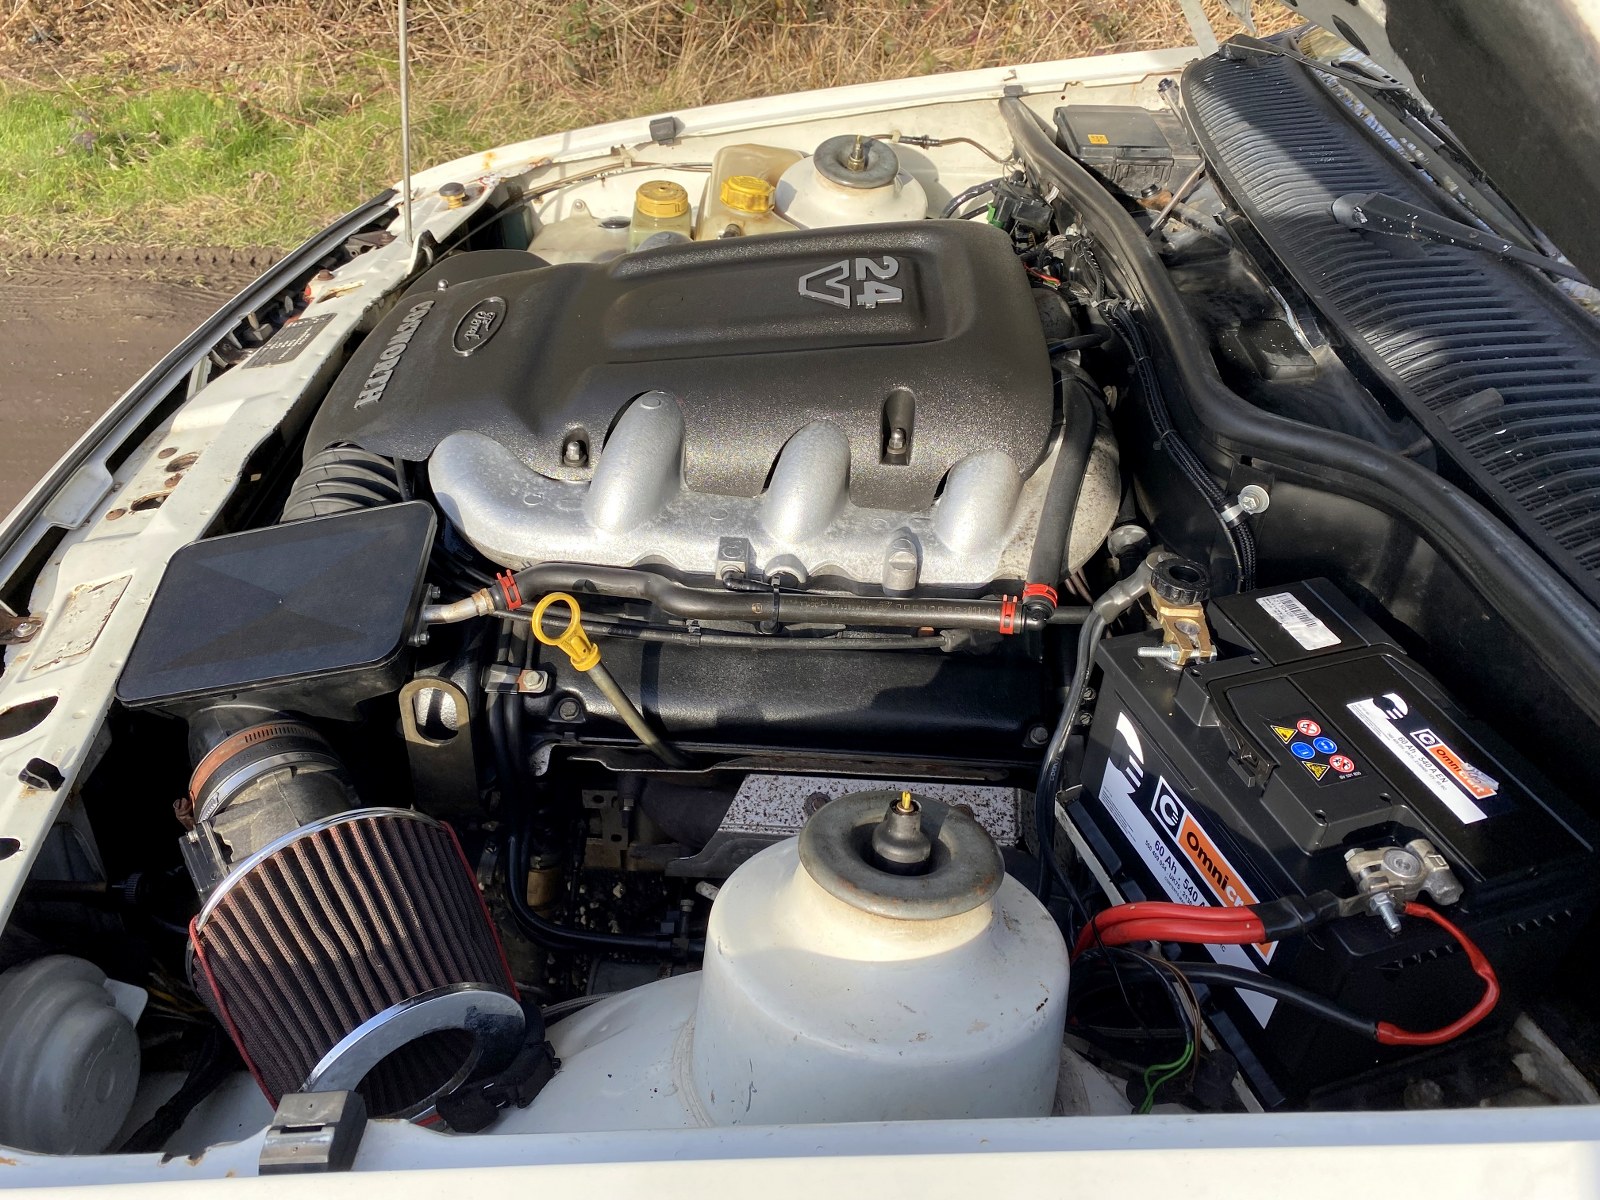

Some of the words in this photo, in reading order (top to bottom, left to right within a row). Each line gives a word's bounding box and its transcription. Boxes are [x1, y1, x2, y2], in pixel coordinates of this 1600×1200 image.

[798, 259, 850, 309] V
[855, 255, 903, 309] 24
[353, 300, 435, 410] COSWORTH
[464, 310, 496, 342] Ford
[1154, 840, 1165, 857] 60
[1164, 855, 1177, 875] Ah
[1182, 878, 1199, 902] 540
[1186, 831, 1245, 907] Omnicr
